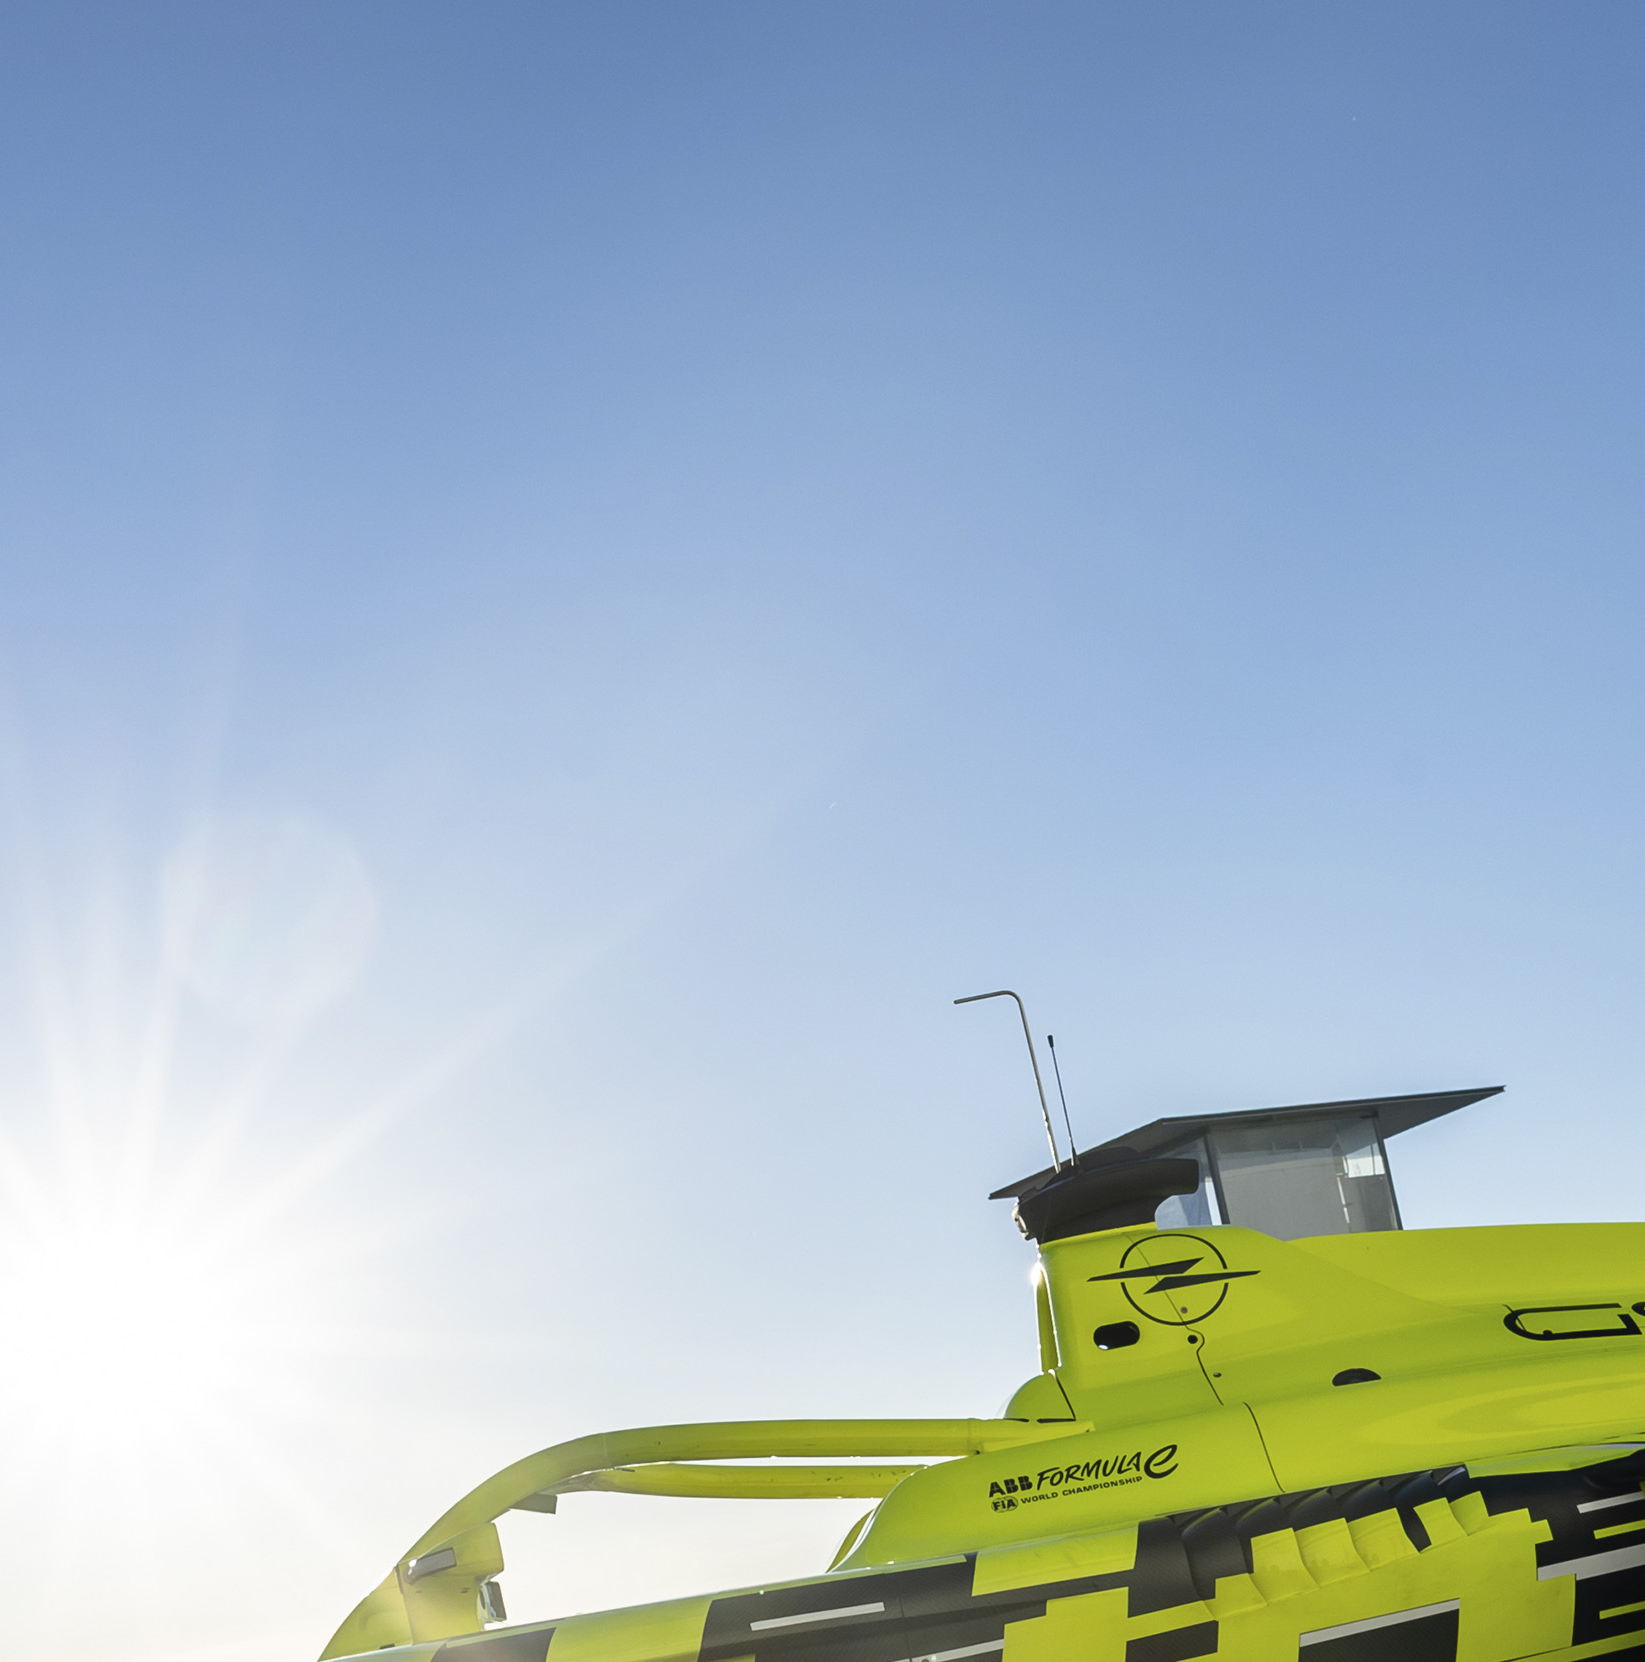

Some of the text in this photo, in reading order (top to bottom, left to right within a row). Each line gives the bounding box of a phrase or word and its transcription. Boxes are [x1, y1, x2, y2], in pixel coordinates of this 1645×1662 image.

[988, 1475, 1033, 1498] ABB
[1036, 1451, 1142, 1491] FORMULA
[992, 1475, 1143, 1512] FIA WORLD CHAMPIONSHIP
